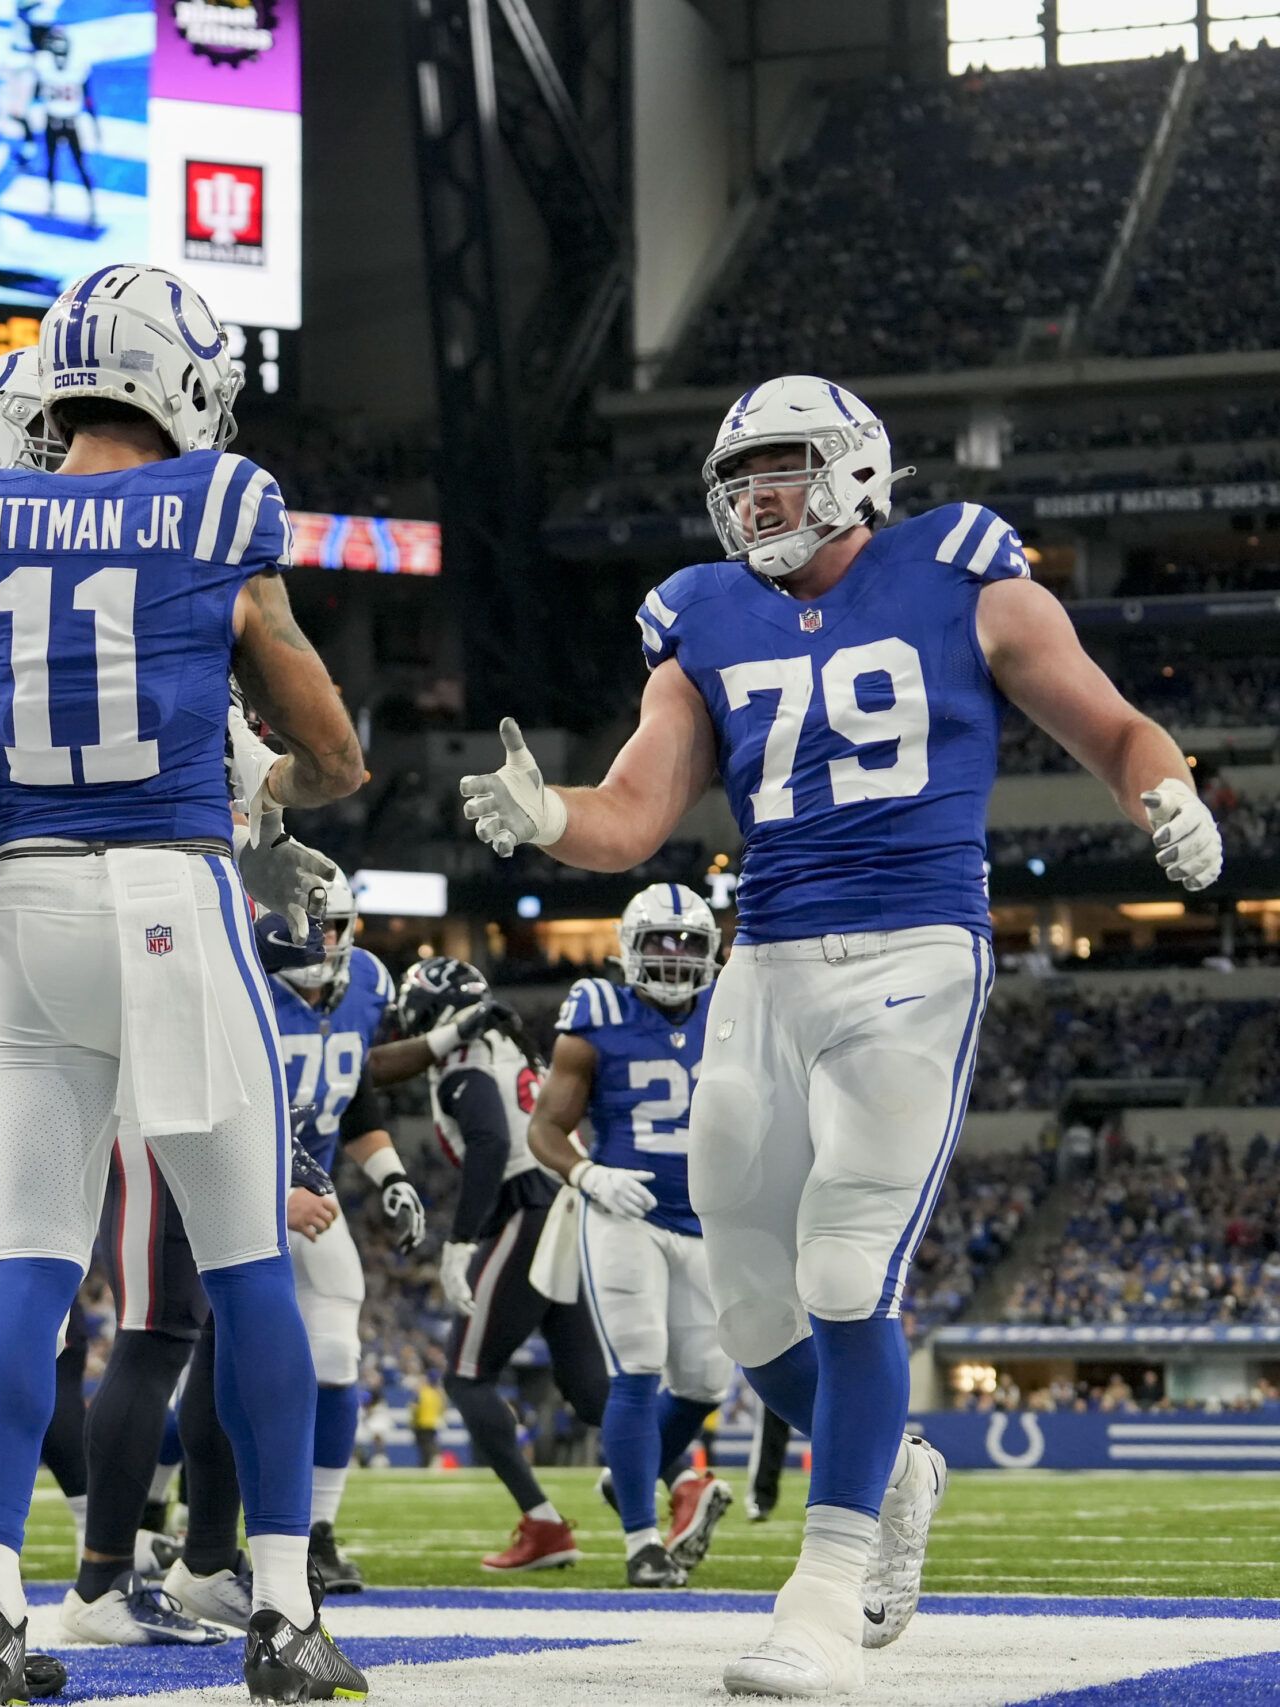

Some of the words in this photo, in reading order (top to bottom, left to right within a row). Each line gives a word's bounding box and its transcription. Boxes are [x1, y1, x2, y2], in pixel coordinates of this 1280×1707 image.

[54, 372, 97, 389] COLTS
[136, 495, 183, 550] JR
[718, 636, 930, 824] 79
[149, 938, 171, 953] NFL
[280, 1031, 363, 1135] 78
[628, 1059, 702, 1154] 2
[270, 1623, 294, 1653] NIKE
